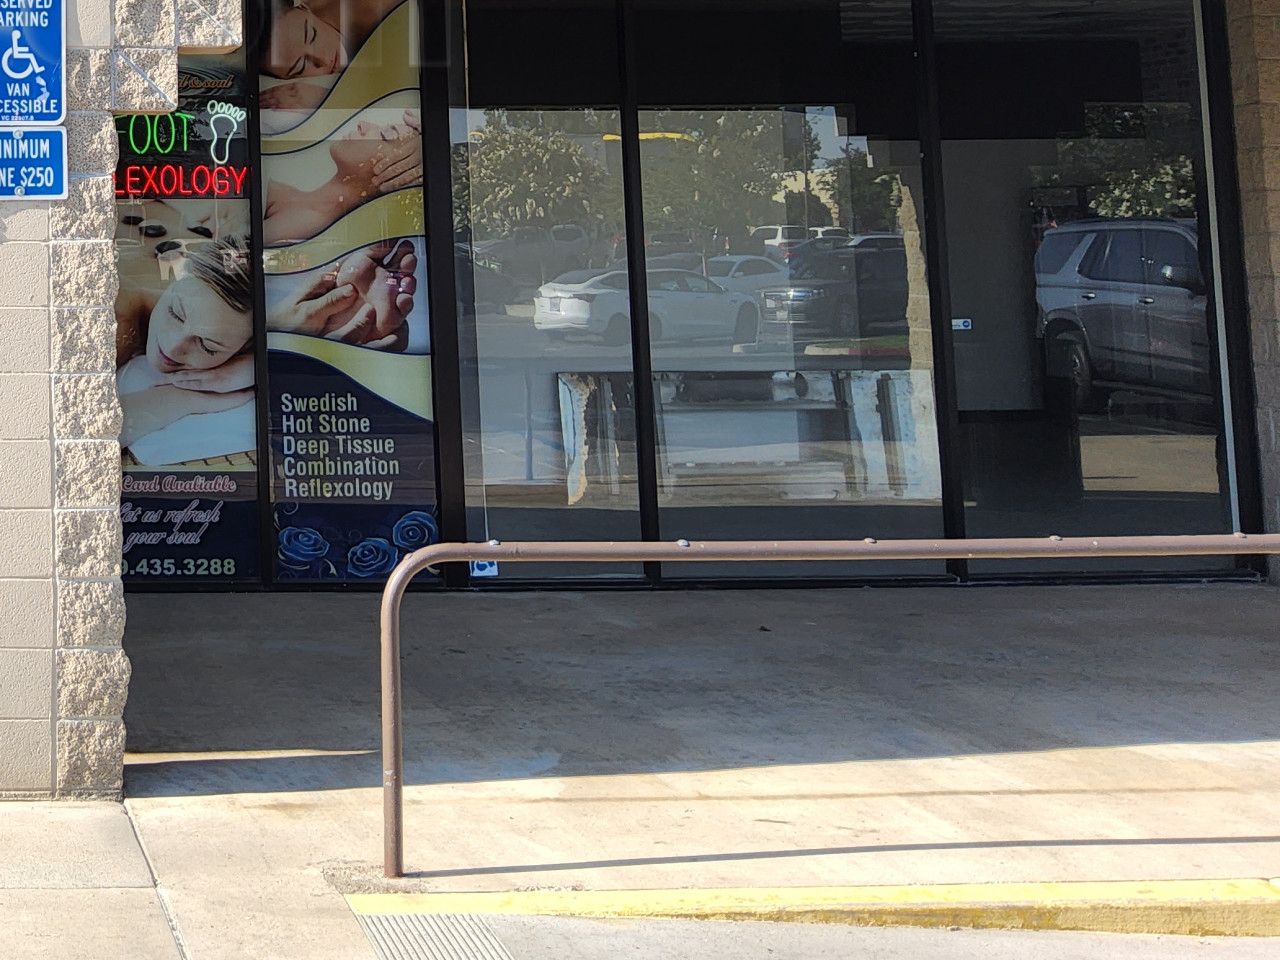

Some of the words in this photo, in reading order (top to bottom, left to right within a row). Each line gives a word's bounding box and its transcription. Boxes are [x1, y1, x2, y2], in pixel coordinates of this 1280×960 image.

[6, 83, 30, 96] VAN
[20, 166, 54, 188] $250
[281, 393, 358, 412] Swedish
[282, 415, 313, 433] Hot
[319, 414, 370, 433] Stone
[283, 436, 329, 458] Deep
[335, 435, 395, 454] Tissue
[284, 456, 400, 476] Combination
[122, 475, 160, 492] Card
[285, 478, 393, 501] Reflexology
[141, 509, 163, 522] us
[163, 499, 224, 532] refresh
[121, 532, 167, 553] your
[166, 522, 209, 544] soul
